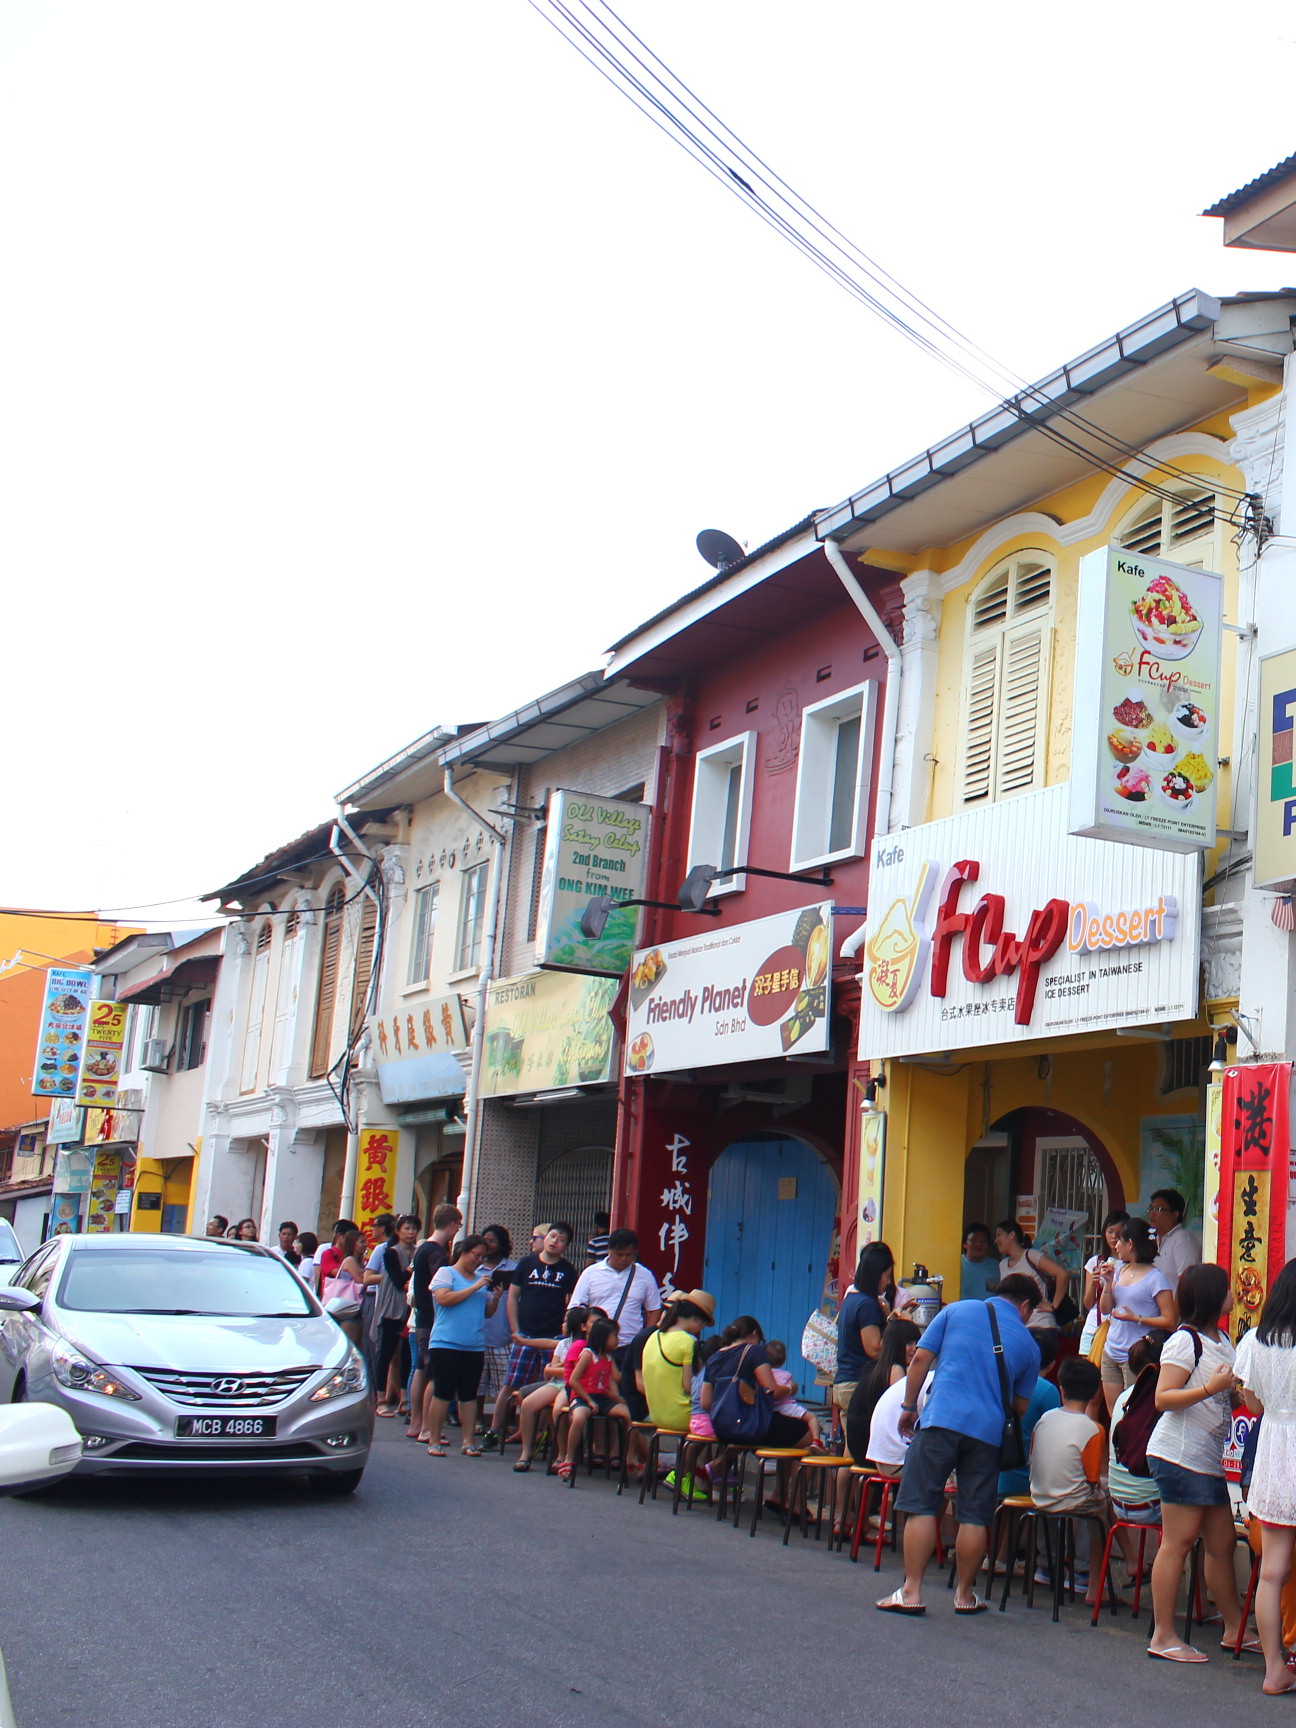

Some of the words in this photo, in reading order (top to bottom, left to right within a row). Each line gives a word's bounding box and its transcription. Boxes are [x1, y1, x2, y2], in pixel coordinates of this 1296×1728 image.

[1117, 560, 1145, 578] Kafe
[1183, 675, 1211, 690] Dessert
[567, 803, 594, 822] Old
[597, 807, 641, 835] Village
[1150, 816, 1167, 824] FREEZE
[1180, 822, 1206, 830] ENTERPRISE
[562, 824, 601, 851] Satay
[572, 851, 591, 866] 2nd
[592, 854, 626, 872] Branch
[877, 845, 904, 869] Kafe
[586, 868, 609, 881] from
[558, 877, 582, 893] ONG
[585, 881, 608, 896] KIM
[1069, 896, 1168, 954] Dessert
[52, 977, 64, 986] BIG
[66, 979, 87, 988] BOWL
[754, 968, 799, 997] 双子星手信
[1045, 972, 1086, 987] SPECIALIST
[1089, 970, 1097, 980] IN
[1099, 962, 1143, 978] TAIWANESE
[495, 982, 536, 1005] RESTORAN
[1045, 989, 1056, 999] ICE
[1058, 984, 1090, 998] DESSERT
[646, 989, 698, 1025] Friendly
[700, 978, 747, 1014] Planet
[93, 1004, 122, 1026] 25
[92, 1028, 122, 1037] TWENTY
[715, 1020, 729, 1036] Sdn
[731, 1016, 746, 1034] Bhd
[97, 1153, 116, 1166] 25
[528, 1268, 539, 1279] A
[554, 1271, 565, 1282] F
[192, 1419, 222, 1434] MCB
[225, 1419, 263, 1434] 4866
